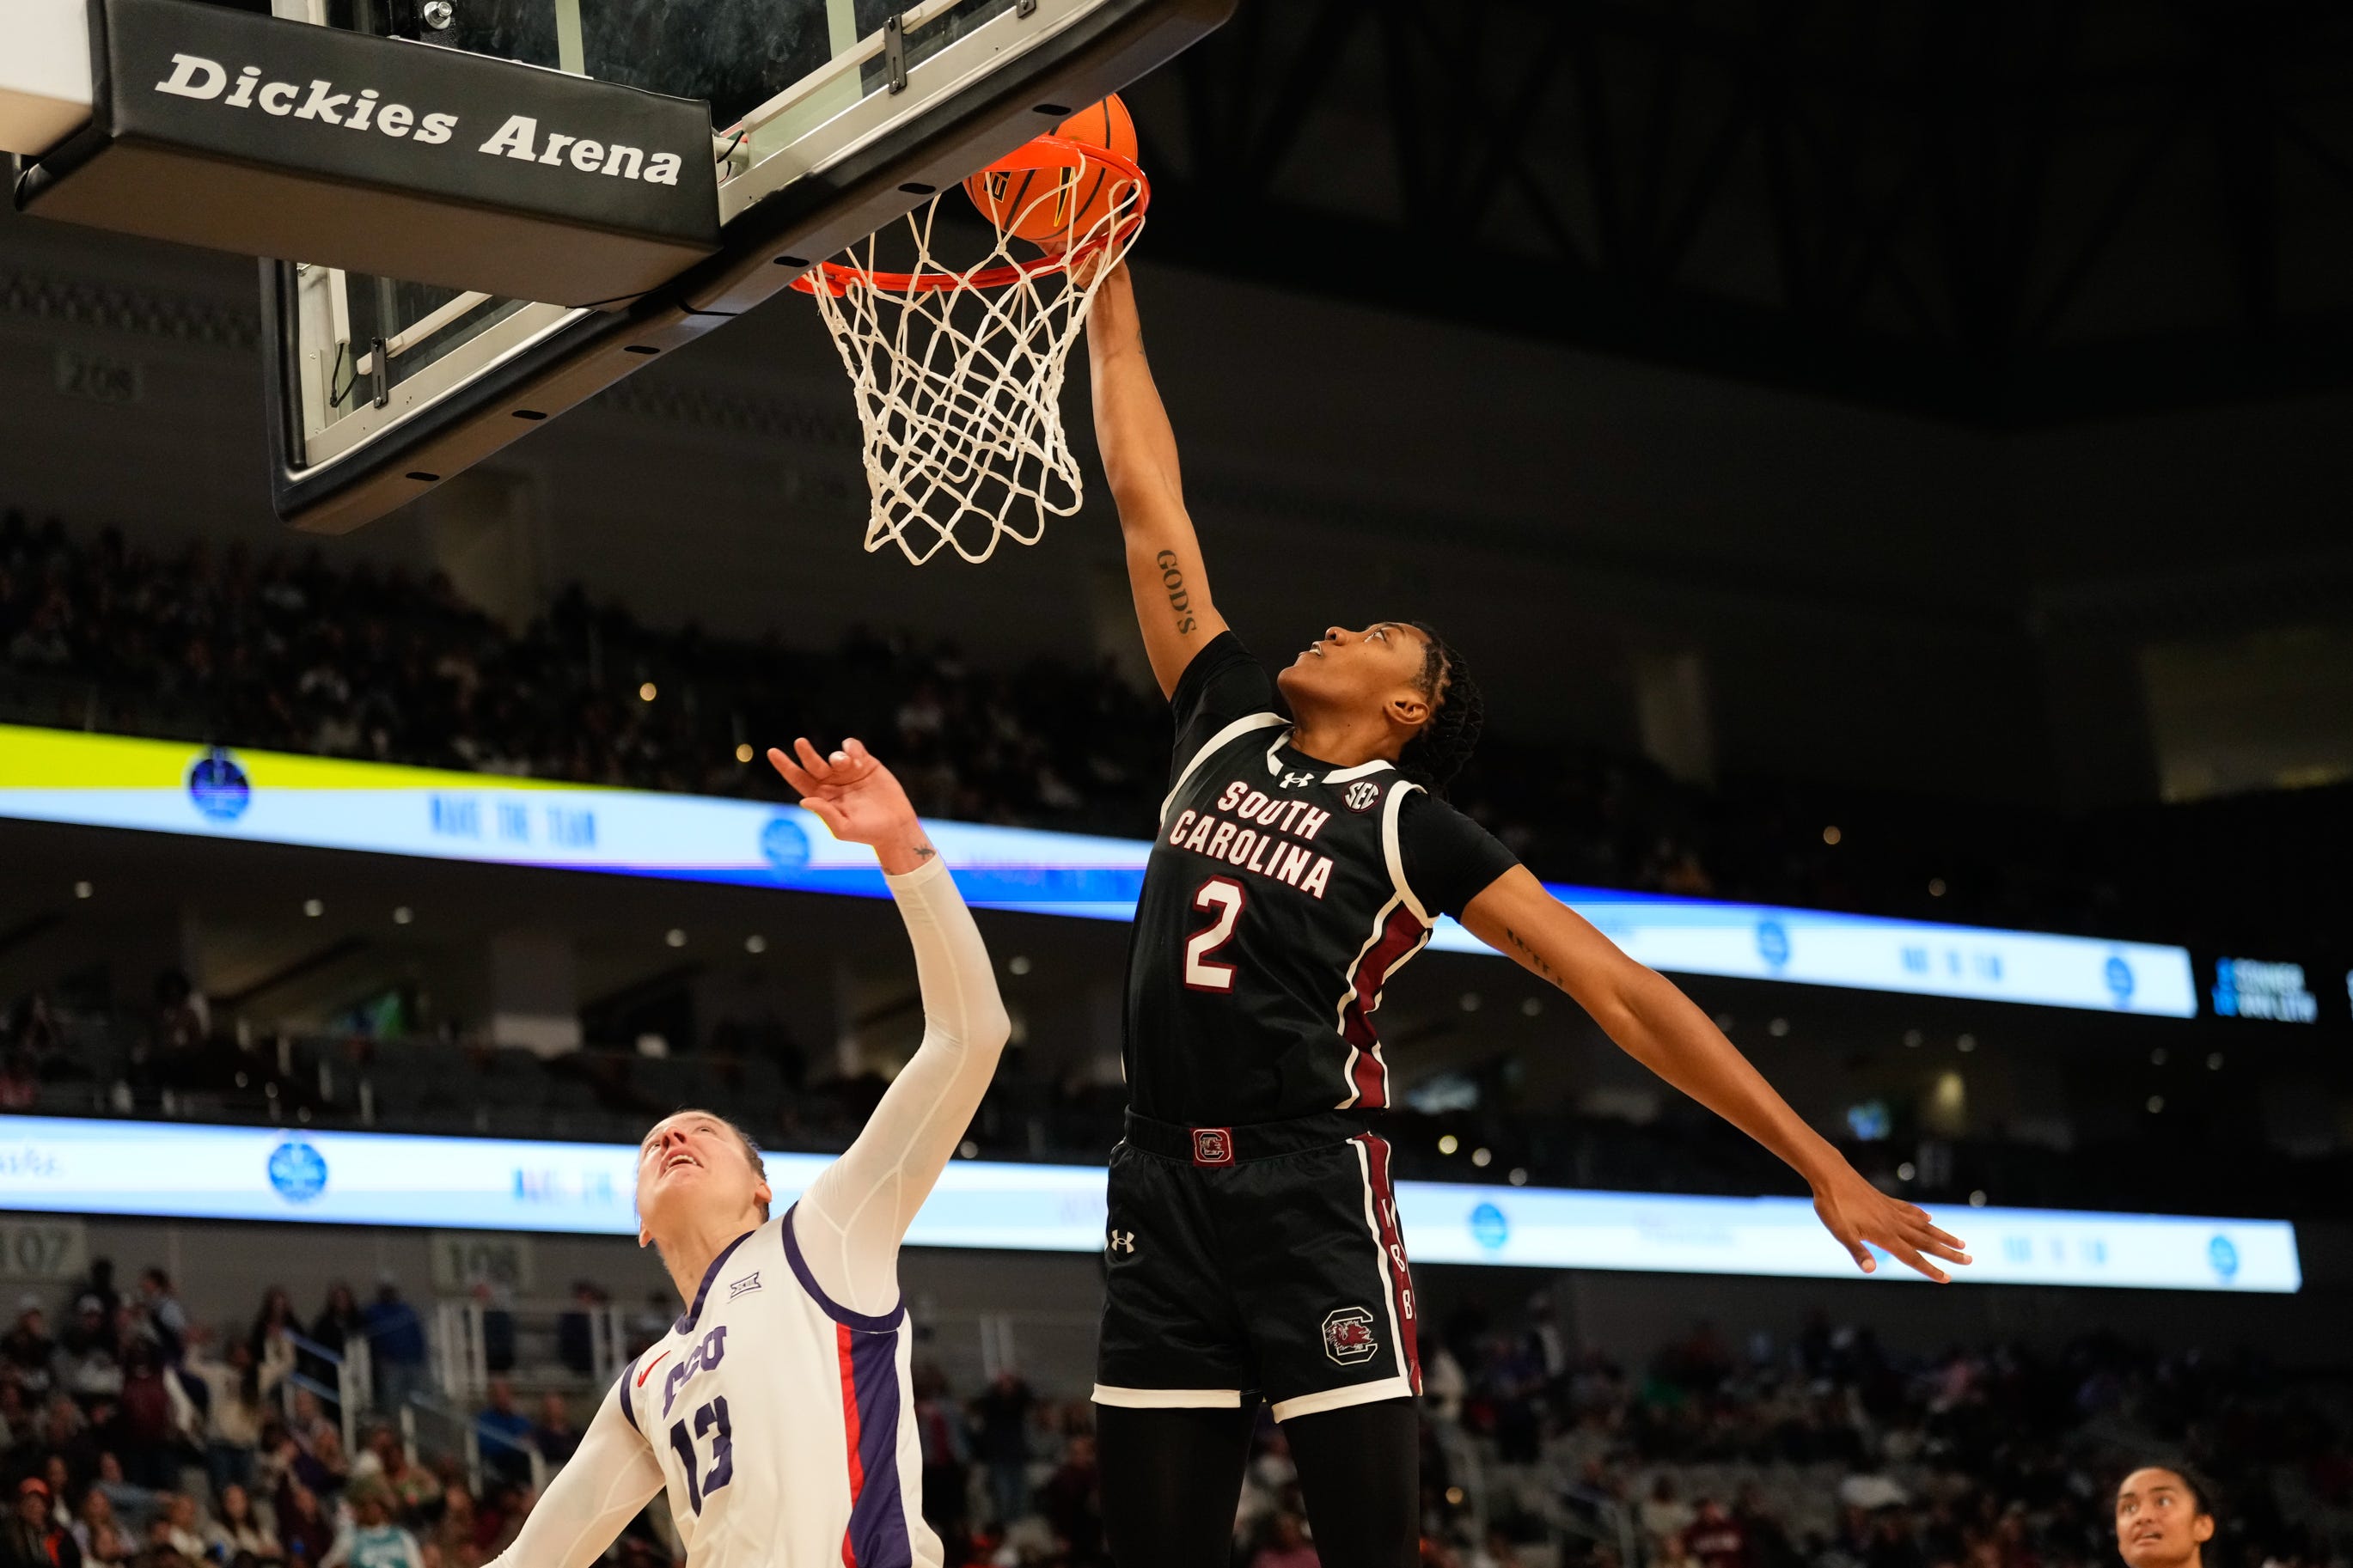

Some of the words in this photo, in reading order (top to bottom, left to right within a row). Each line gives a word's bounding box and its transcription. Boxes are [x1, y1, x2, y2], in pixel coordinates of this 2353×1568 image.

[155, 53, 457, 145] Dickies
[479, 114, 683, 186] Arena
[1157, 549, 1196, 634] GOD'S
[1217, 780, 1331, 840] SOUTH
[1344, 781, 1381, 811] SEC
[1169, 809, 1335, 900] CAROLINA
[1183, 875, 1246, 994] 2
[669, 1395, 733, 1517] 13
